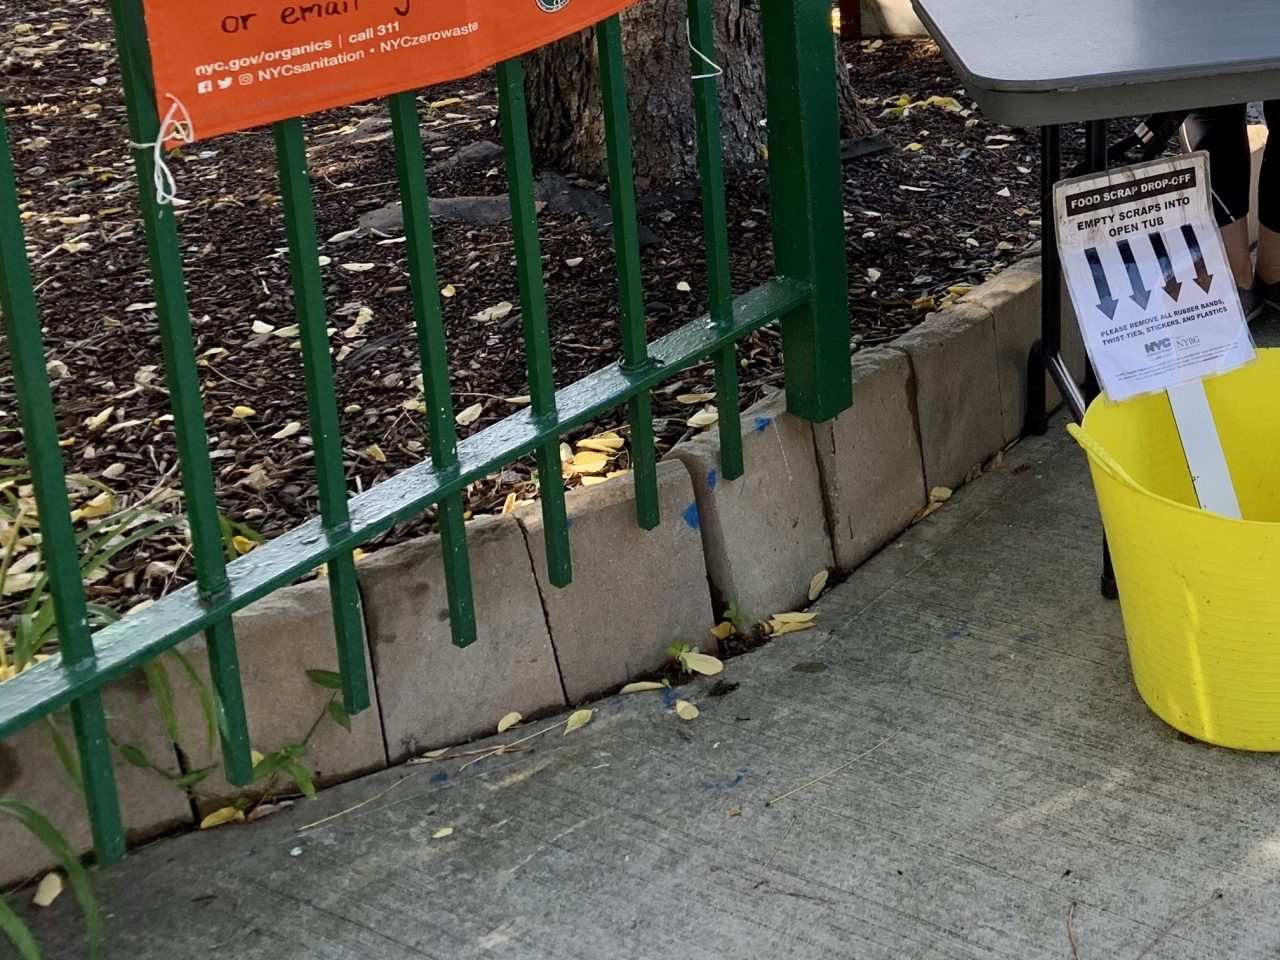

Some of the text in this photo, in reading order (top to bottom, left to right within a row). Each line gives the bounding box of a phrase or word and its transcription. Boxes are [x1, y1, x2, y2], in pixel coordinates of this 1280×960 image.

[220, 12, 258, 34] or
[194, 21, 400, 76] nyc.gov/organics call 311
[257, 21, 479, 82] NYCsanitation NYCzerowaste
[1070, 173, 1192, 209] FOOD SCRAP DROP-OFF
[1077, 196, 1190, 231] EMPTY SCRAPS INTO
[1108, 216, 1164, 238] OPEN TUB
[1101, 299, 1225, 337] PLEASE REMOVE ALL RUBBER BANDS,
[1146, 320, 1182, 333] STICKERS,
[1182, 315, 1196, 323] AND
[1196, 306, 1228, 320] PLASTICS
[1144, 336, 1200, 353] NYC NYBG
